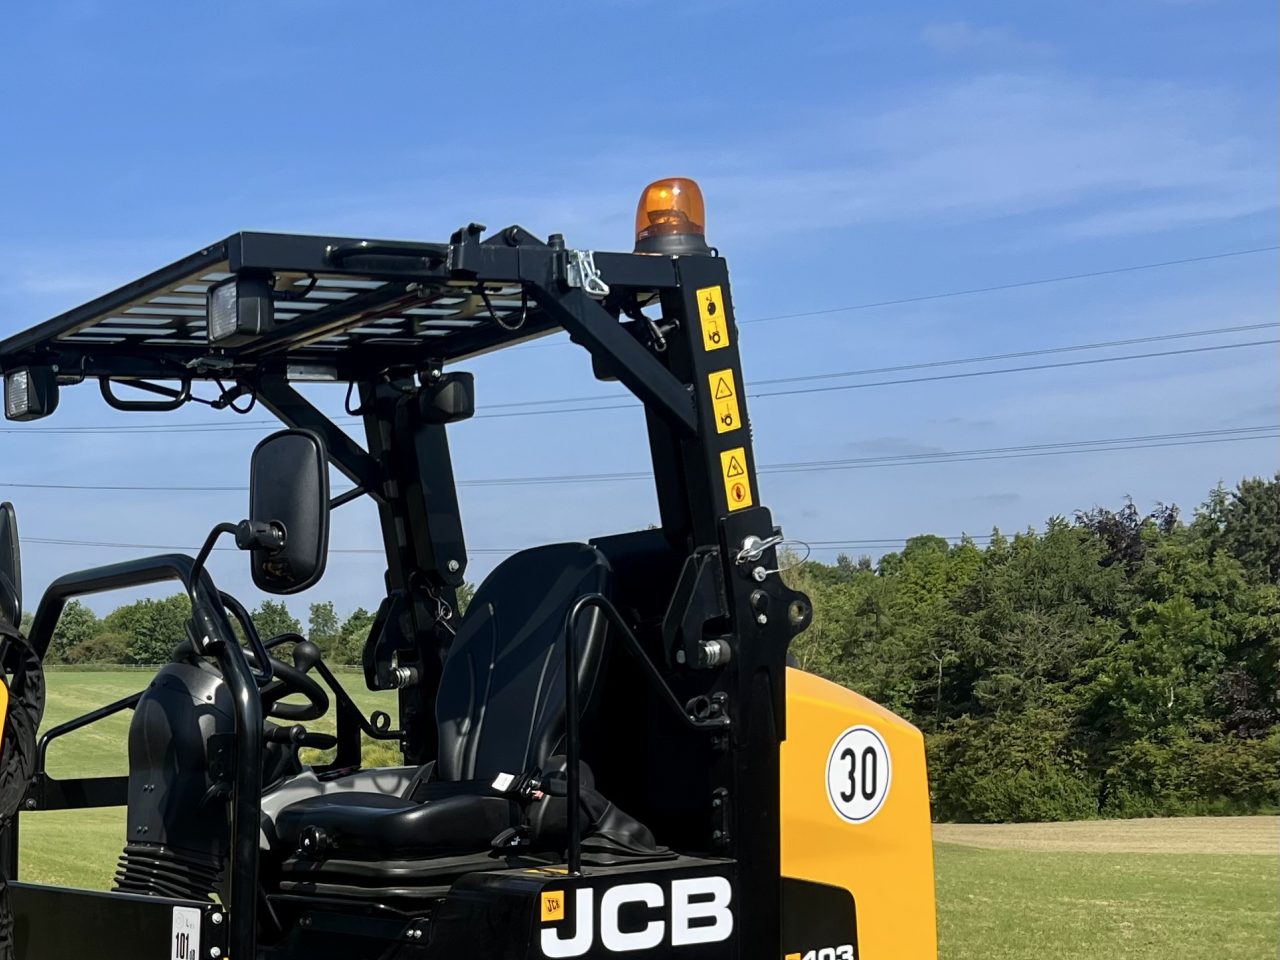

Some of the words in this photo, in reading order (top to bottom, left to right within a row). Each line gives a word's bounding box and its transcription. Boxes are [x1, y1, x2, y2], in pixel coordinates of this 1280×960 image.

[840, 745, 878, 803] 30
[540, 875, 734, 959] JCB
[545, 896, 561, 914] JCB
[175, 932, 189, 960] 101
